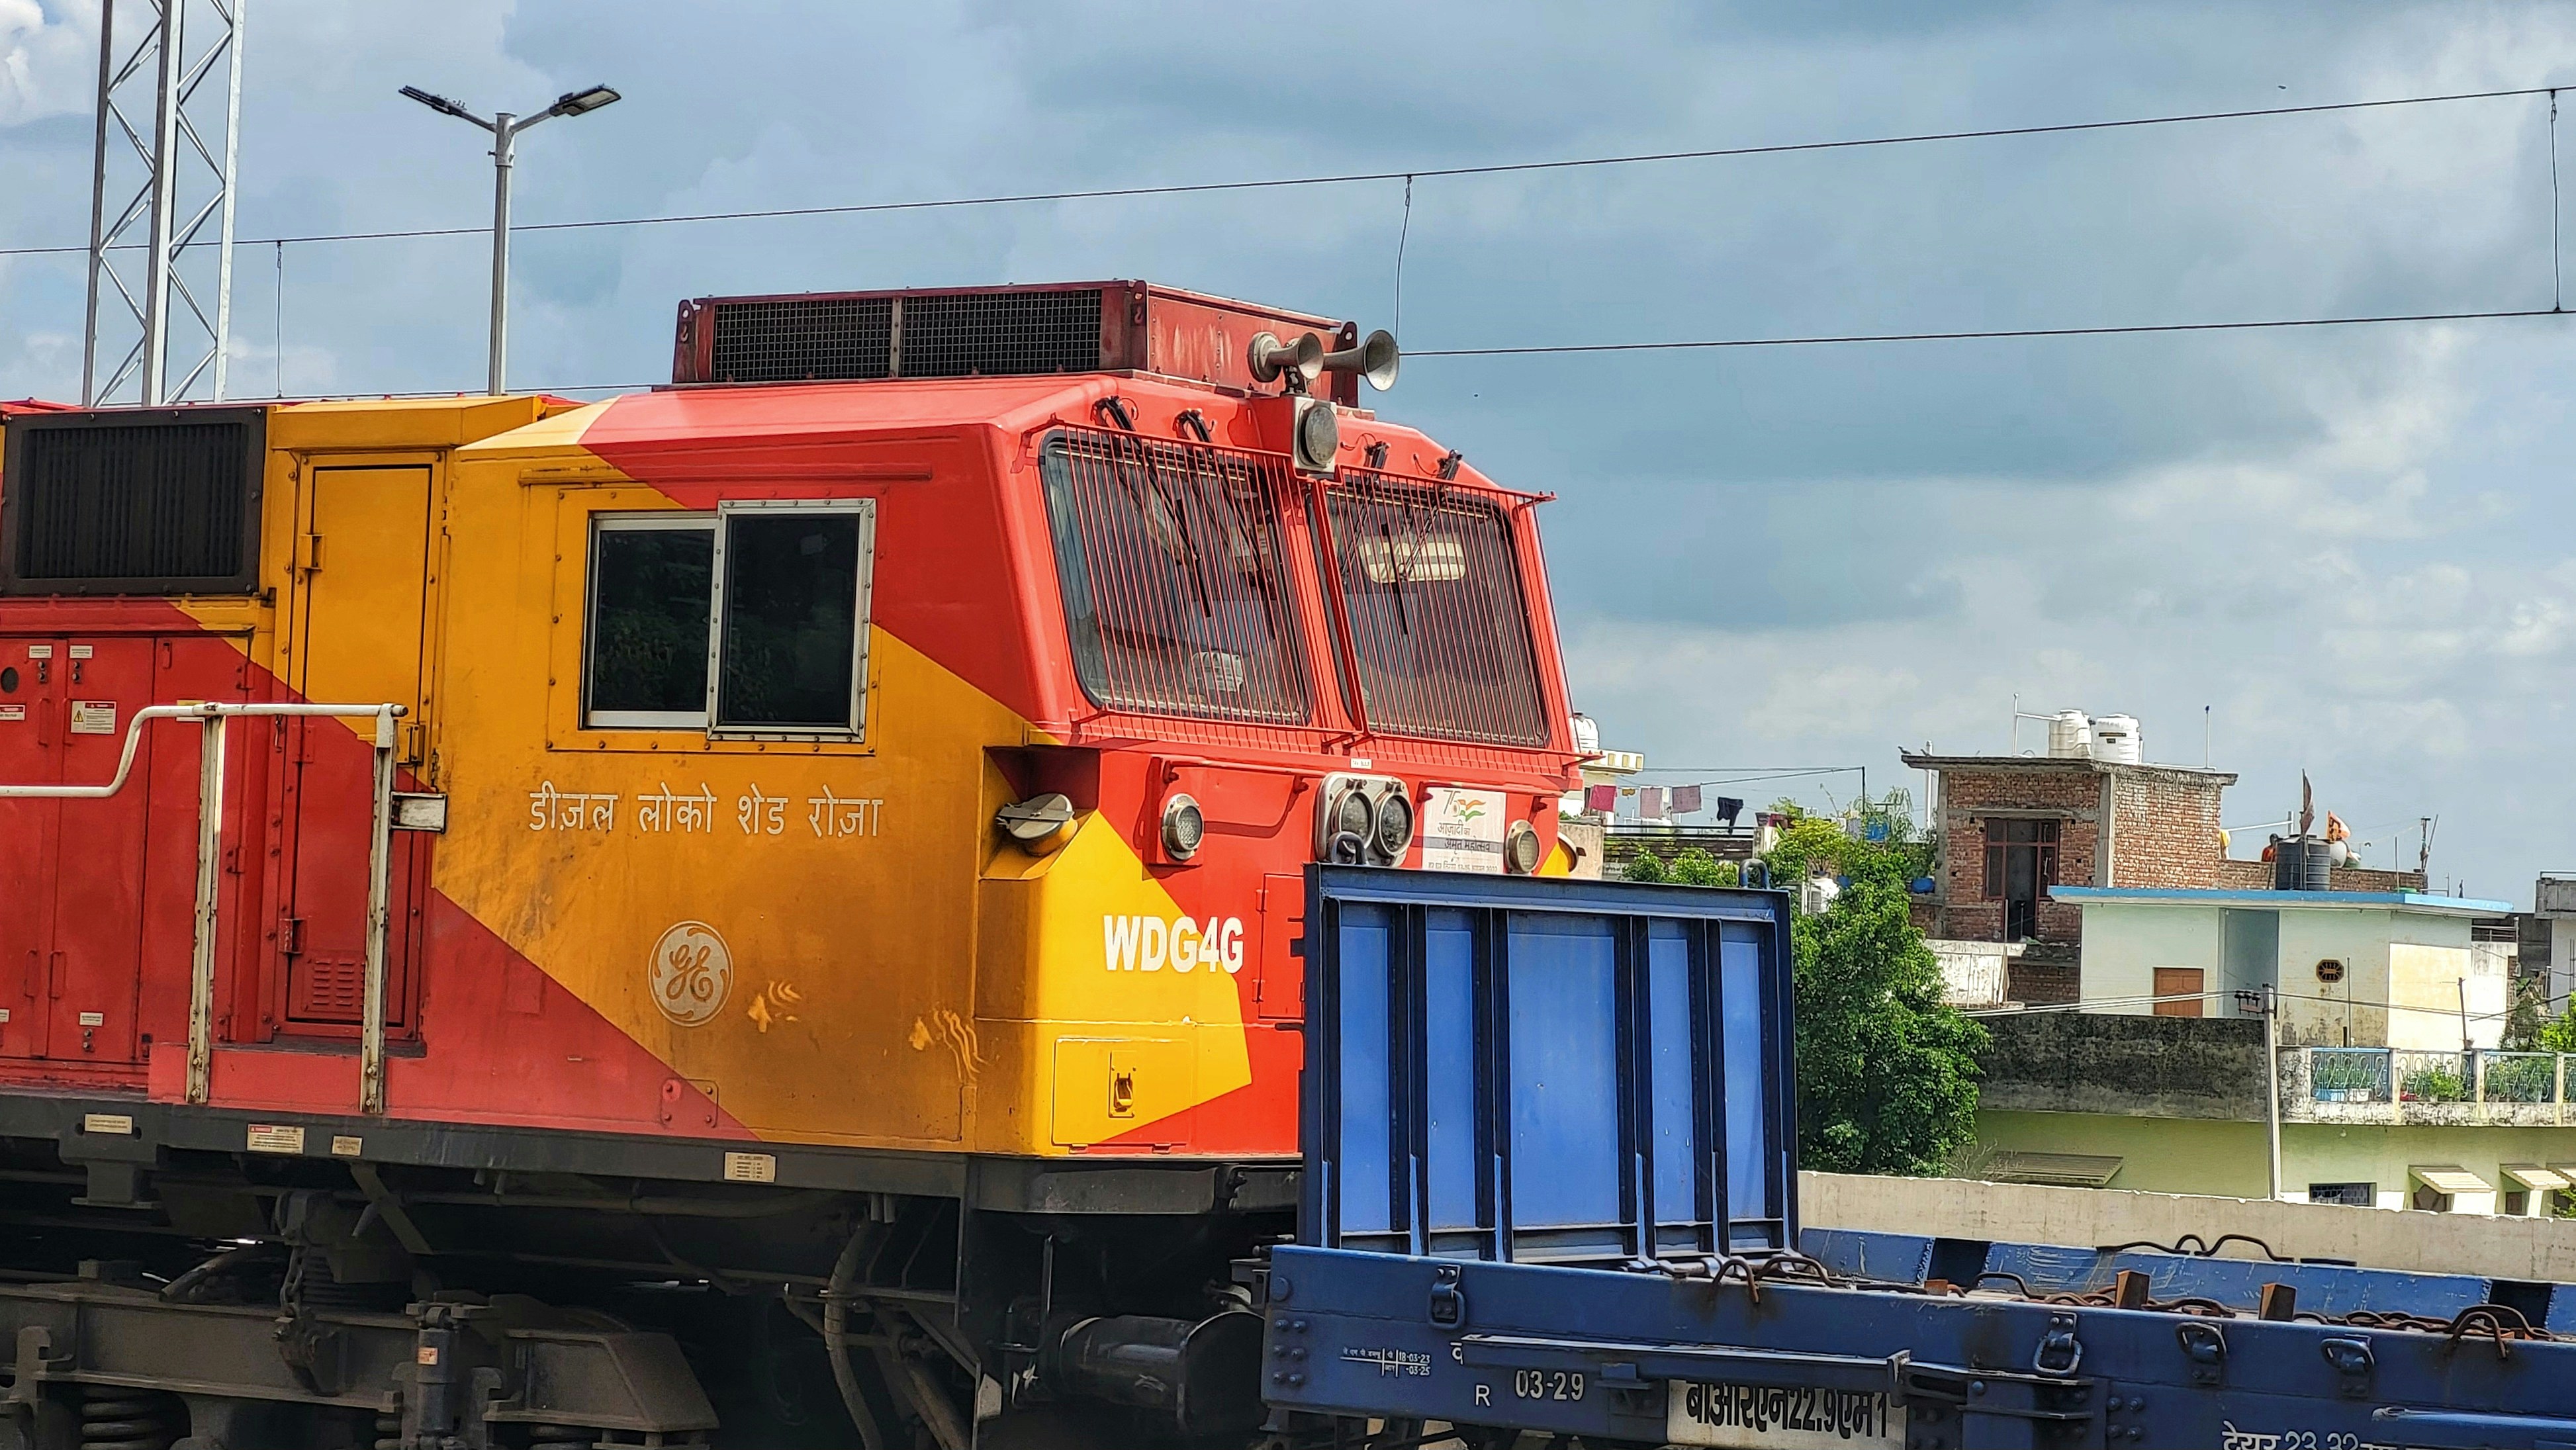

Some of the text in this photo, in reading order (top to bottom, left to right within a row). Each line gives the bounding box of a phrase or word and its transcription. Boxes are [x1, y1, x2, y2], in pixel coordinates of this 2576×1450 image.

[637, 782, 717, 833] लोको
[737, 783, 788, 835] शेड
[807, 784, 883, 837] रोज़ा
[1103, 915, 1244, 974] WDG4G
[1475, 1384, 1491, 1406] R
[1516, 1370, 1584, 1400] 03-29
